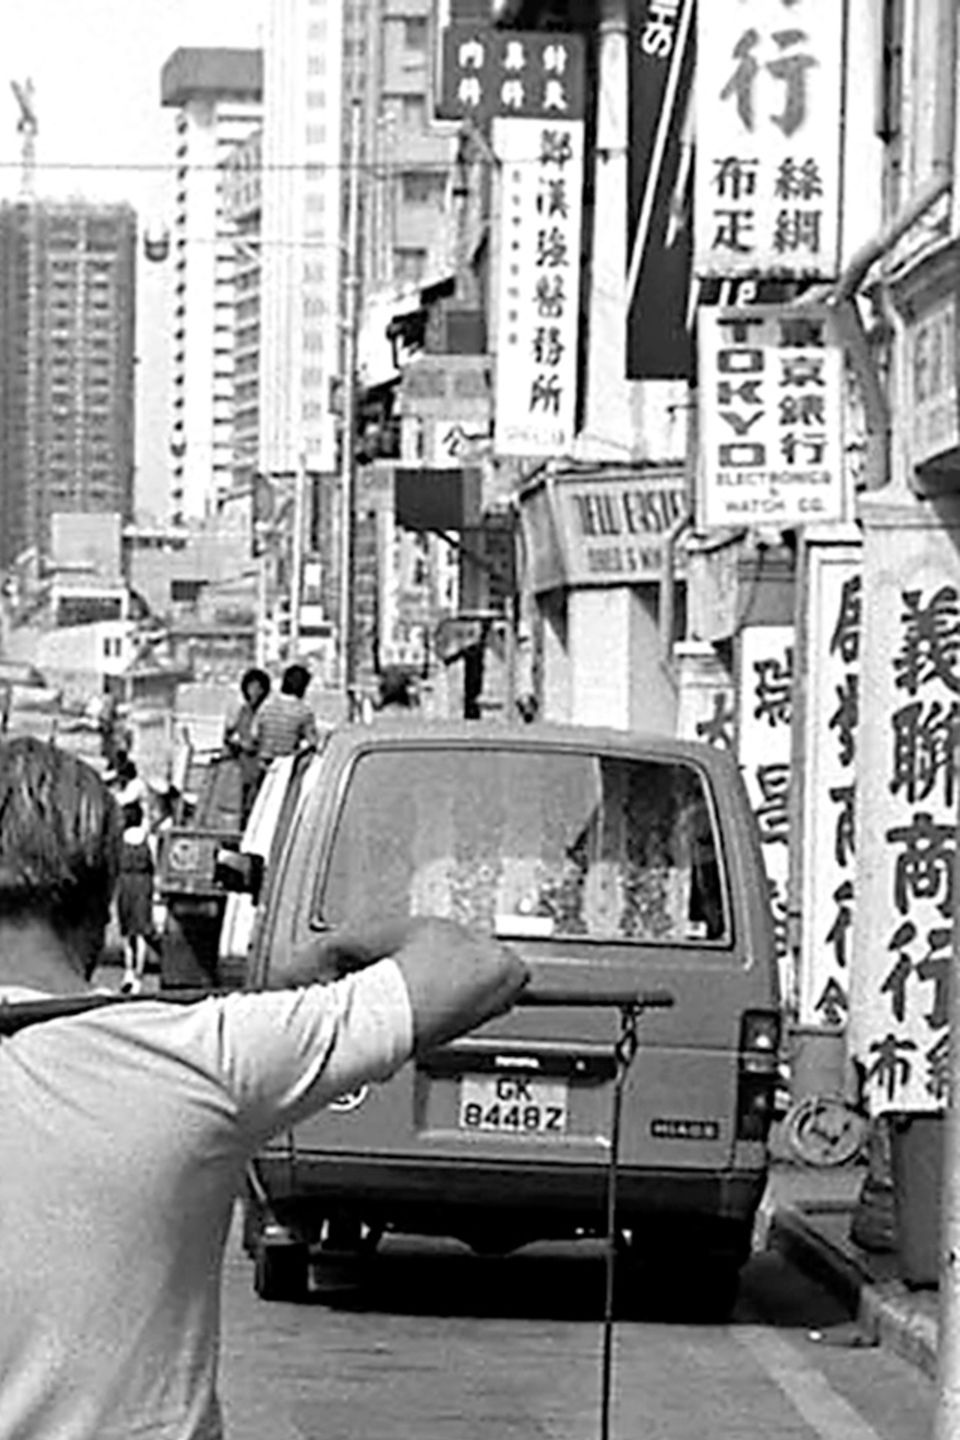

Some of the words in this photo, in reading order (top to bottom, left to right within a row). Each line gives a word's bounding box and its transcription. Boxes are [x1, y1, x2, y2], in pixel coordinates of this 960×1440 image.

[720, 0, 820, 138] 行
[716, 317, 767, 468] TOKYO
[464, 1103, 564, 1131] 8448Z
[496, 1077, 532, 1102] GK
